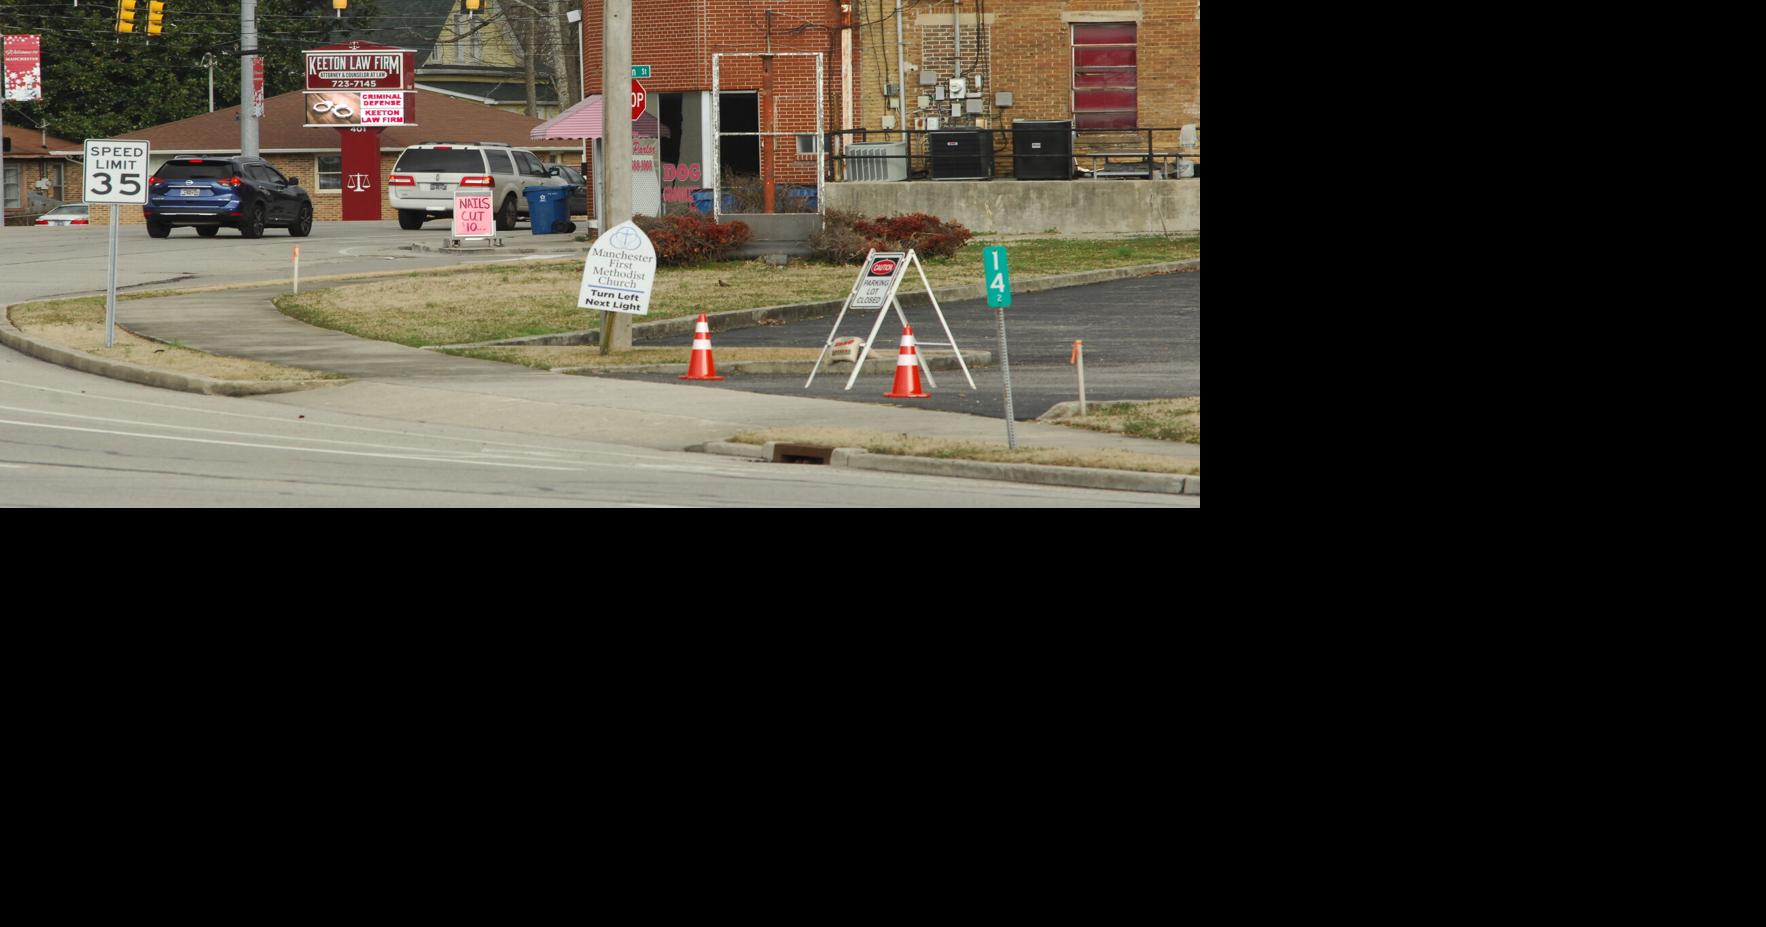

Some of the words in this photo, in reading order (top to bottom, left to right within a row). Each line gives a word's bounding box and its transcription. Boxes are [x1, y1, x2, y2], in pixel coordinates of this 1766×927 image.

[309, 56, 346, 75] KEETON
[350, 56, 371, 70] LAW
[374, 56, 399, 75] FIRM
[631, 92, 644, 107] OP
[90, 146, 143, 157] SPEED
[96, 159, 137, 170] LIMIT
[662, 163, 701, 182] DOG
[90, 172, 141, 196] 35
[459, 197, 490, 209] NAILS
[461, 210, 485, 221] CUT
[592, 247, 654, 263] Manchester
[608, 258, 634, 270] First
[592, 266, 646, 281] Methodist
[598, 275, 637, 289] Church
[590, 289, 615, 299] Turn
[617, 292, 640, 302] Left
[997, 294, 1002, 302] 2
[585, 298, 611, 308] Next
[613, 301, 641, 311] Light
